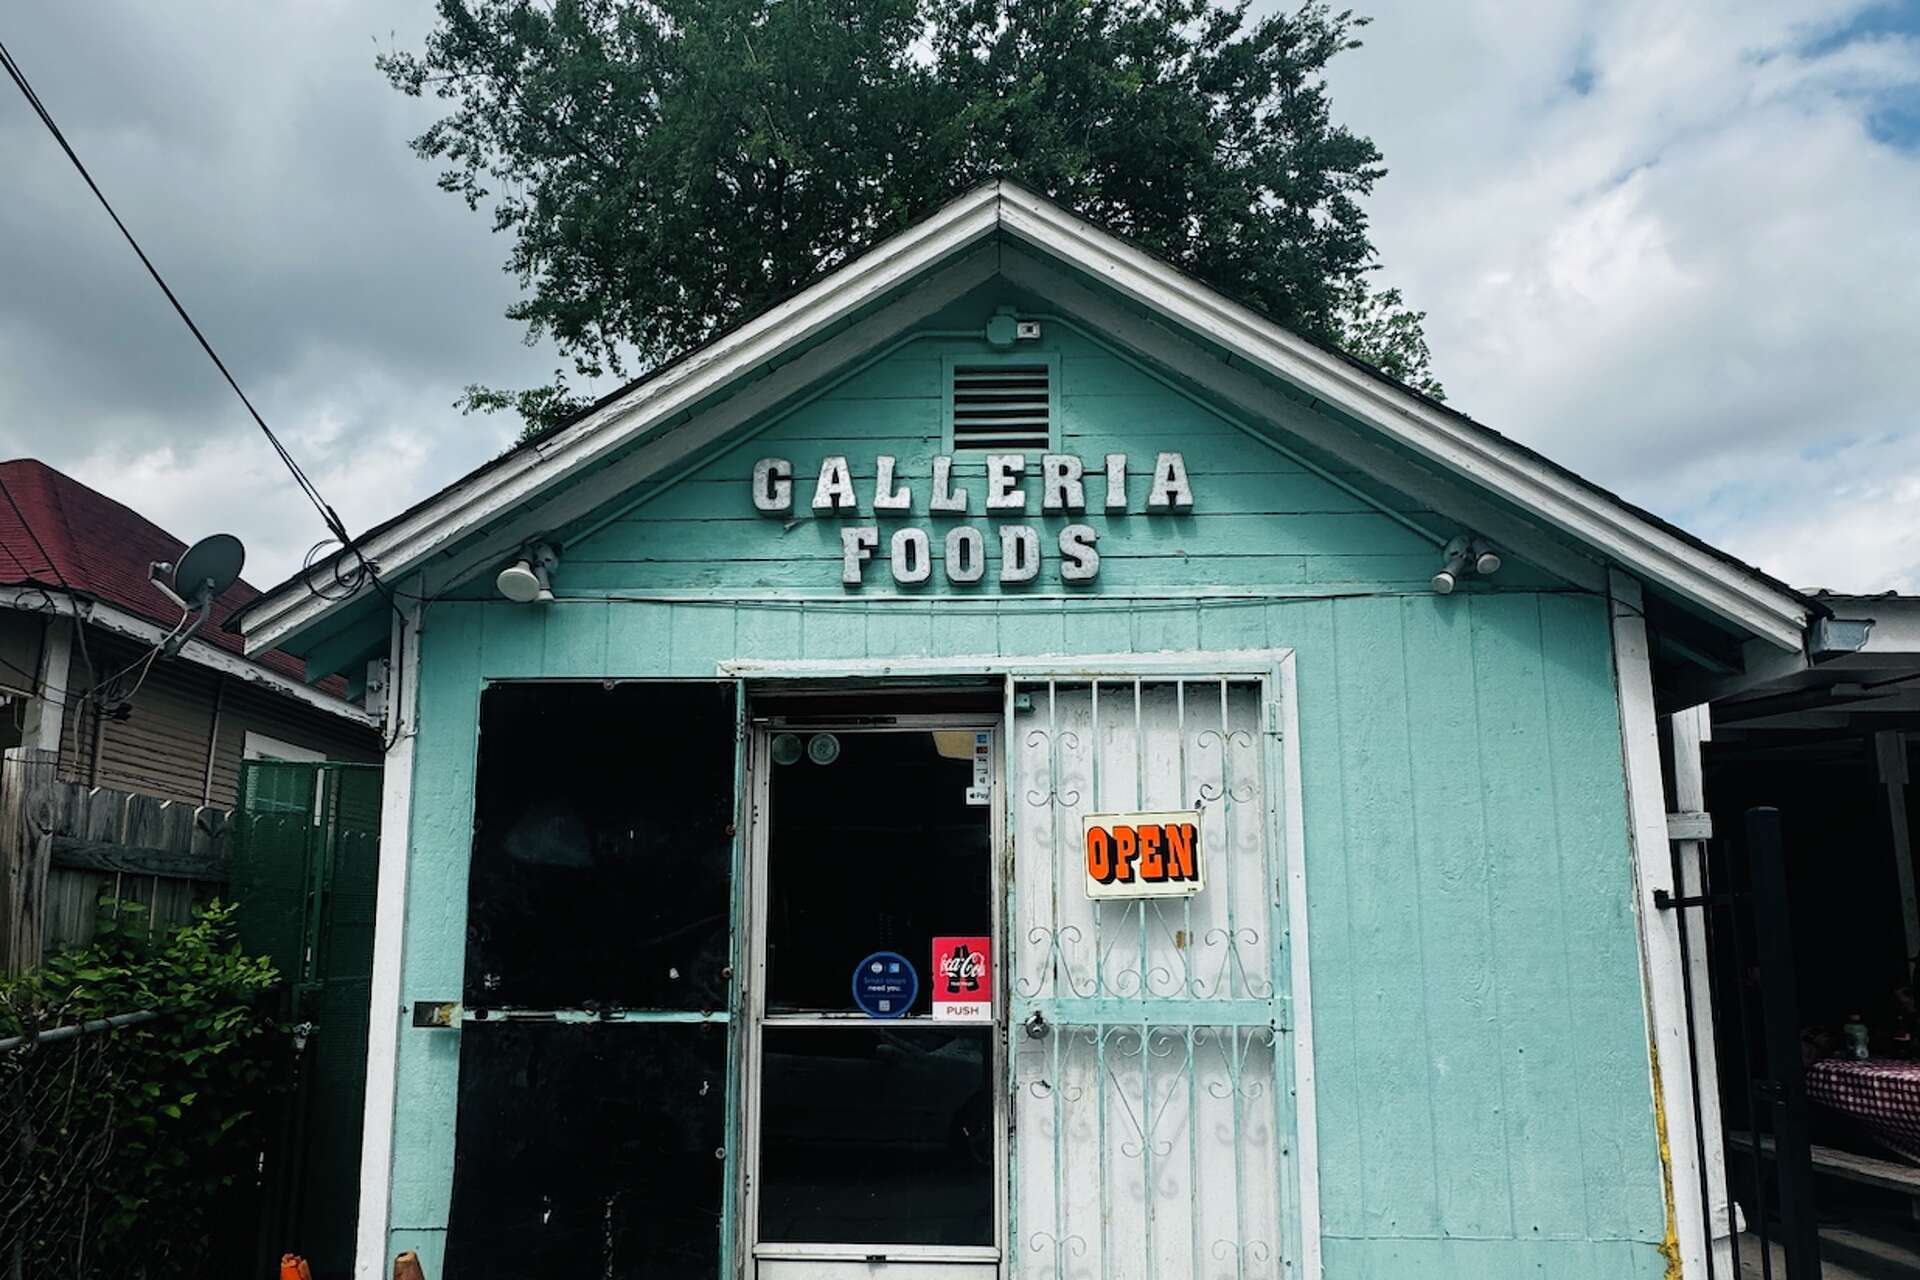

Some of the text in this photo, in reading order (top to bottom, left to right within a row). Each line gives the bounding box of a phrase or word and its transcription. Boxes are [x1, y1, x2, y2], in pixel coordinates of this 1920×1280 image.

[752, 452, 1194, 515] GALLERIA
[841, 524, 1100, 586] FOODS
[1087, 823, 1199, 884] OPEN
[867, 984, 886, 992] need
[947, 1006, 979, 1015] PUSH
